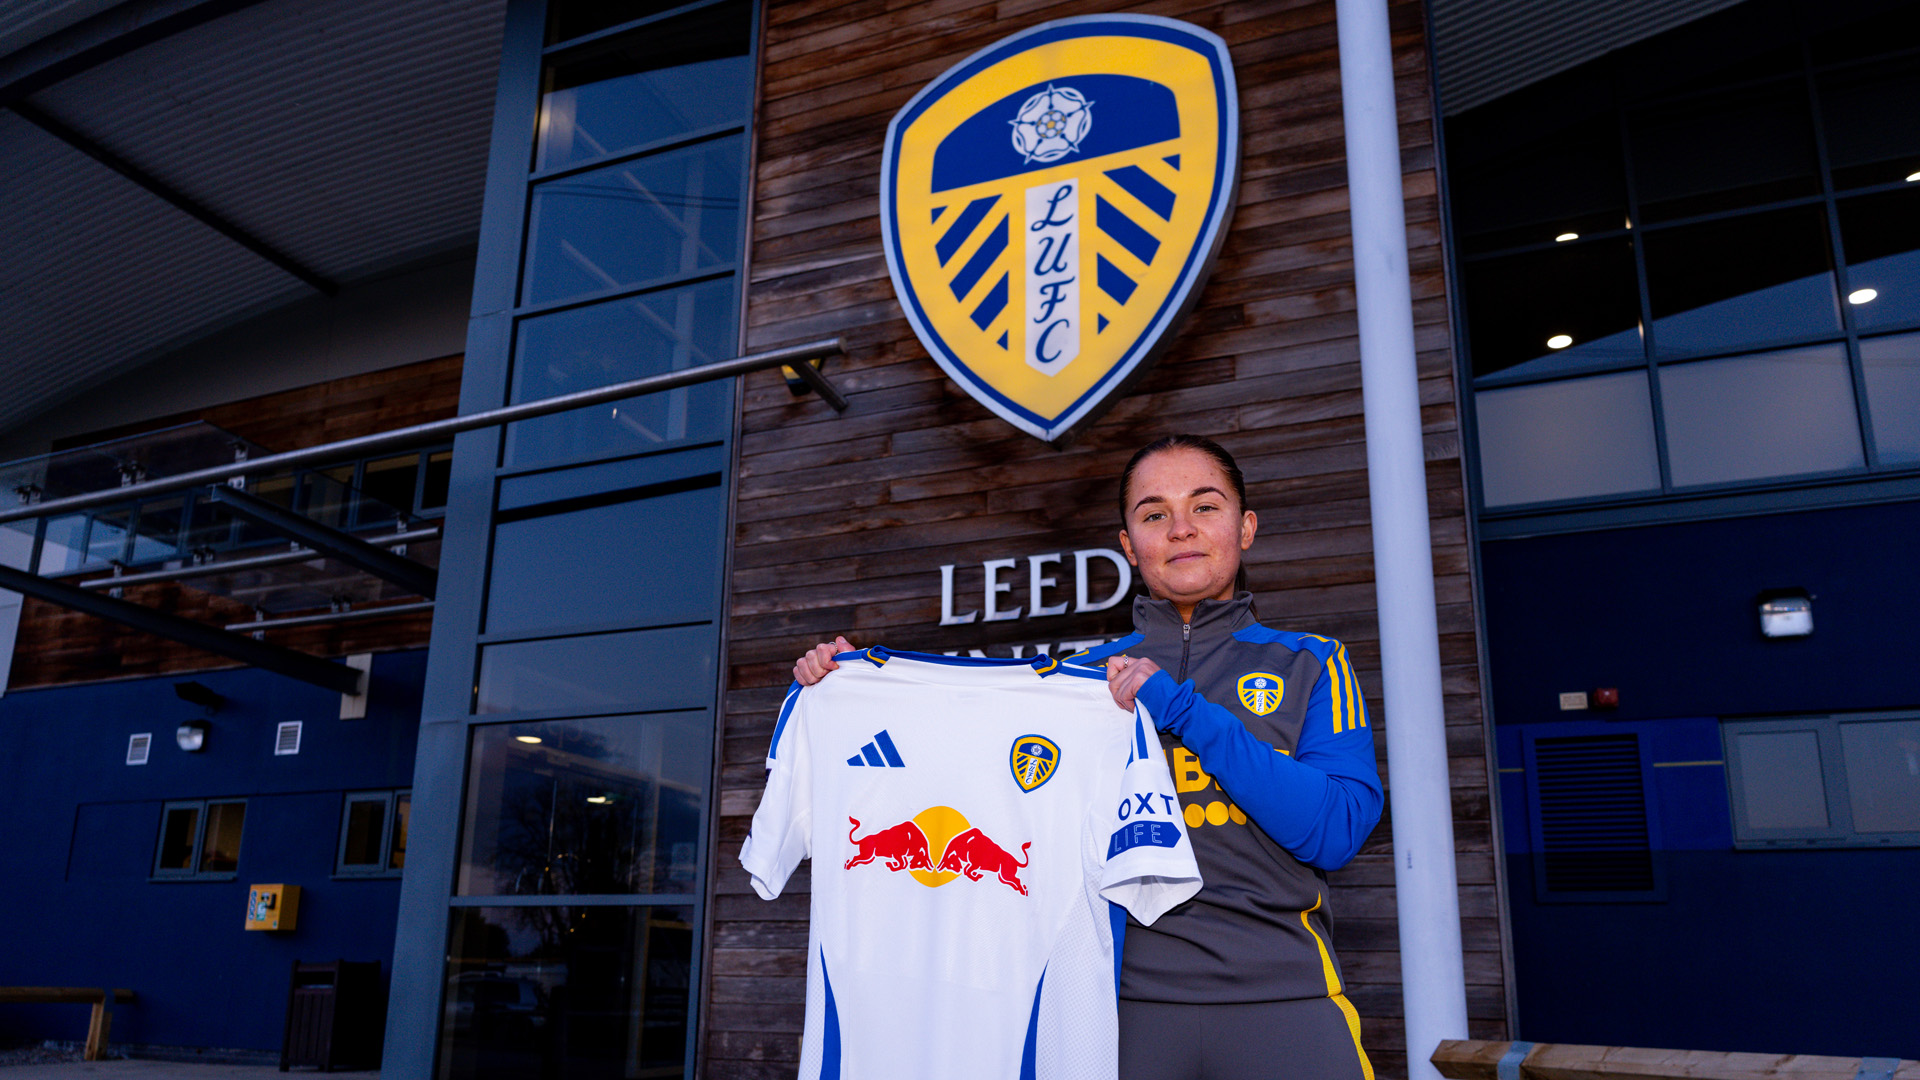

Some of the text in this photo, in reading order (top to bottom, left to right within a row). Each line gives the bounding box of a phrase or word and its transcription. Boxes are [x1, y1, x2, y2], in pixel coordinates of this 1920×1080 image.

[1031, 184, 1075, 363] LUFC
[939, 548, 1132, 626] LEED
[1118, 792, 1174, 821] OXT
[1114, 823, 1163, 853] LIFE
